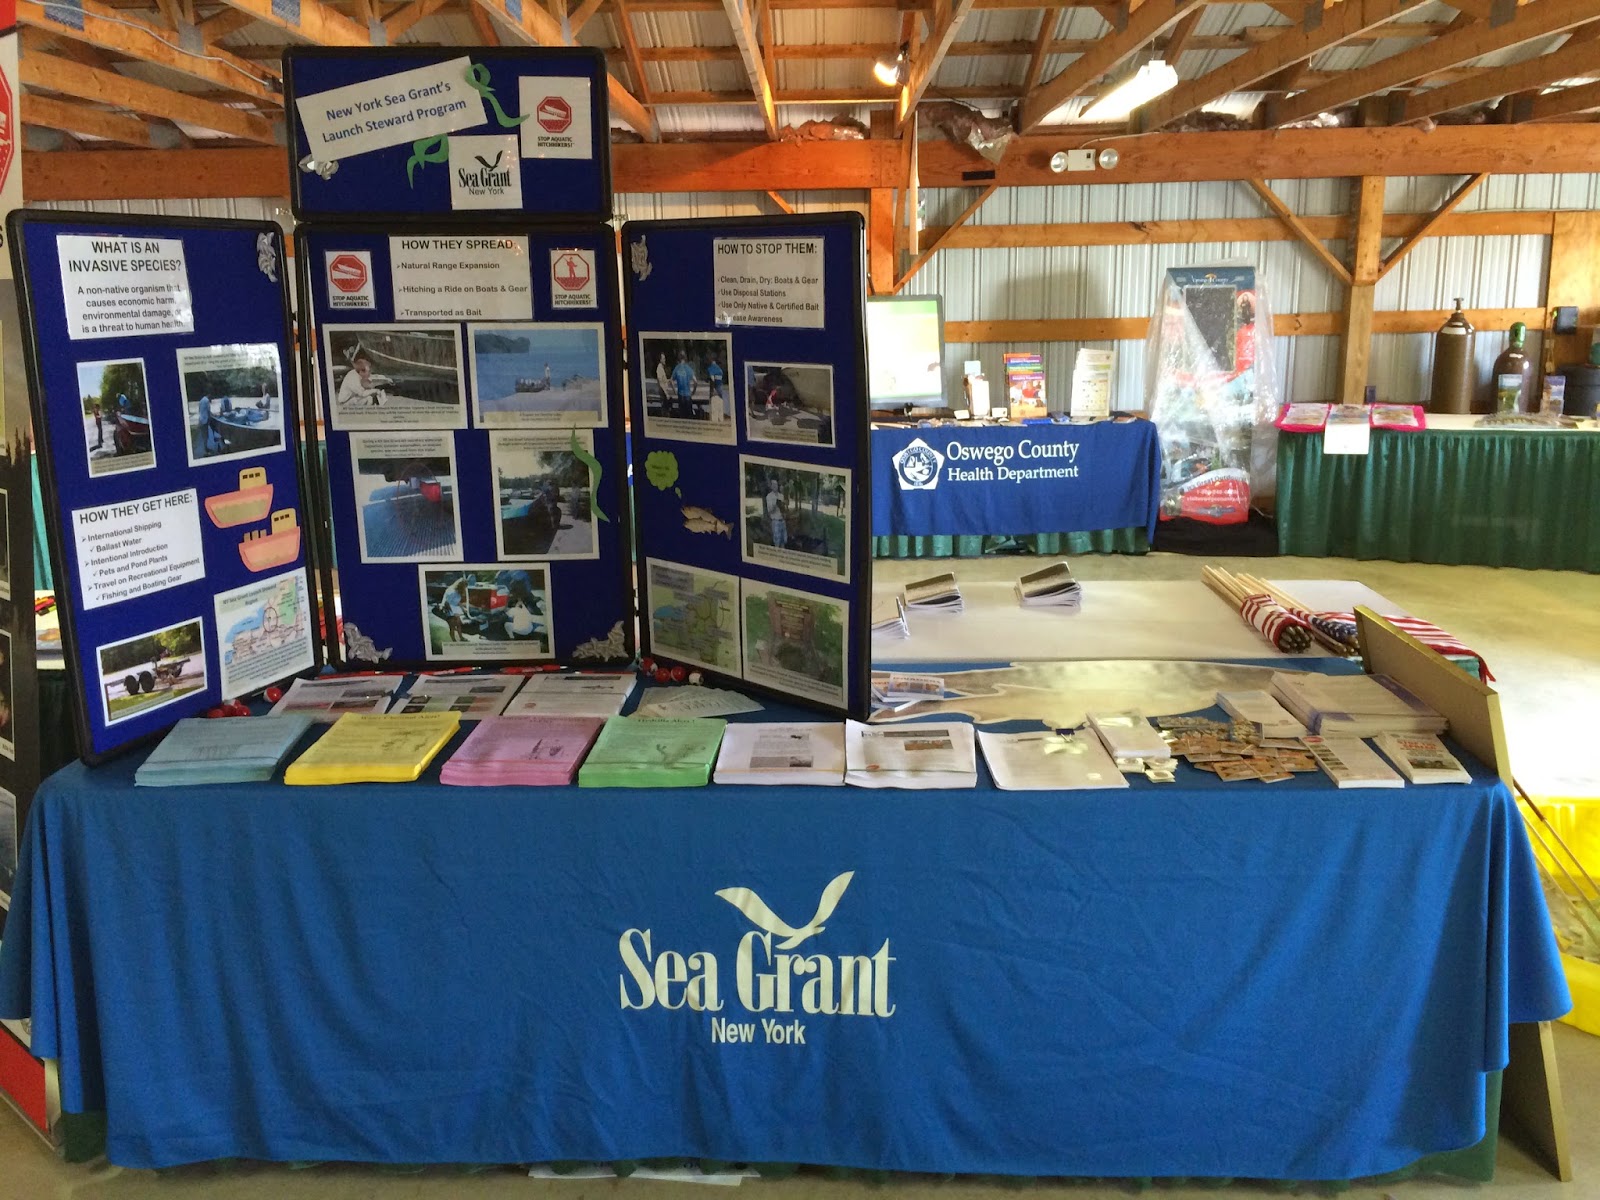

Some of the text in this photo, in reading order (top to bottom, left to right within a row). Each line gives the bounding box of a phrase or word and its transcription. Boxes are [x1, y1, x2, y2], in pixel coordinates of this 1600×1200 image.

[326, 81, 452, 121] New York Sea Grant's
[322, 99, 467, 143] Launch Steward Program
[458, 167, 512, 188] Sea Grant
[469, 187, 504, 195] New York
[91, 241, 160, 254] WHAT IS AN
[402, 239, 518, 250] HOW THEY SPREAD:
[717, 243, 818, 254] HOW TO STOP THEM:
[68, 259, 182, 272] INVASIVE SPECIES?
[401, 261, 500, 271] Natural Range Expansion
[774, 276, 793, 284] Boats
[795, 276, 800, 284] &
[801, 276, 819, 284] Gear
[78, 286, 85, 295] A
[86, 285, 130, 295] non-native
[131, 285, 165, 295] organism
[403, 285, 436, 295] Hitching
[444, 285, 462, 293] Ride
[476, 285, 499, 293] Boats
[500, 285, 506, 293] &
[508, 285, 528, 293] Gear
[733, 289, 759, 298] Disposal
[759, 289, 786, 297] Stations
[86, 299, 116, 307] causes
[118, 296, 154, 306] economic
[721, 301, 732, 309] Use
[733, 301, 747, 311] Only
[775, 302, 804, 310] Certified
[805, 302, 819, 311] Bait
[82, 309, 140, 321] environmental
[142, 308, 174, 319] damage,
[405, 309, 453, 318] Transported
[466, 308, 482, 316] Bait
[747, 315, 783, 323] Awareness
[82, 325, 89, 333] is
[100, 322, 124, 333] threat
[125, 323, 134, 331] to
[135, 321, 160, 330] human
[946, 439, 1079, 466] Oswego County
[948, 465, 1079, 483] Health Department
[79, 493, 193, 524] HOW THEY GET HERE:
[87, 521, 162, 542] International Shipping
[96, 537, 142, 553] Ballast Water
[90, 543, 168, 566] Intentional Introduction
[99, 554, 168, 577] Pets and Pond Plants
[94, 557, 200, 590] Travel on Recreational Equipment
[102, 574, 182, 601] Fishing and Boating Gear
[619, 928, 897, 1018] Sea Grant
[711, 1017, 806, 1044] New York
